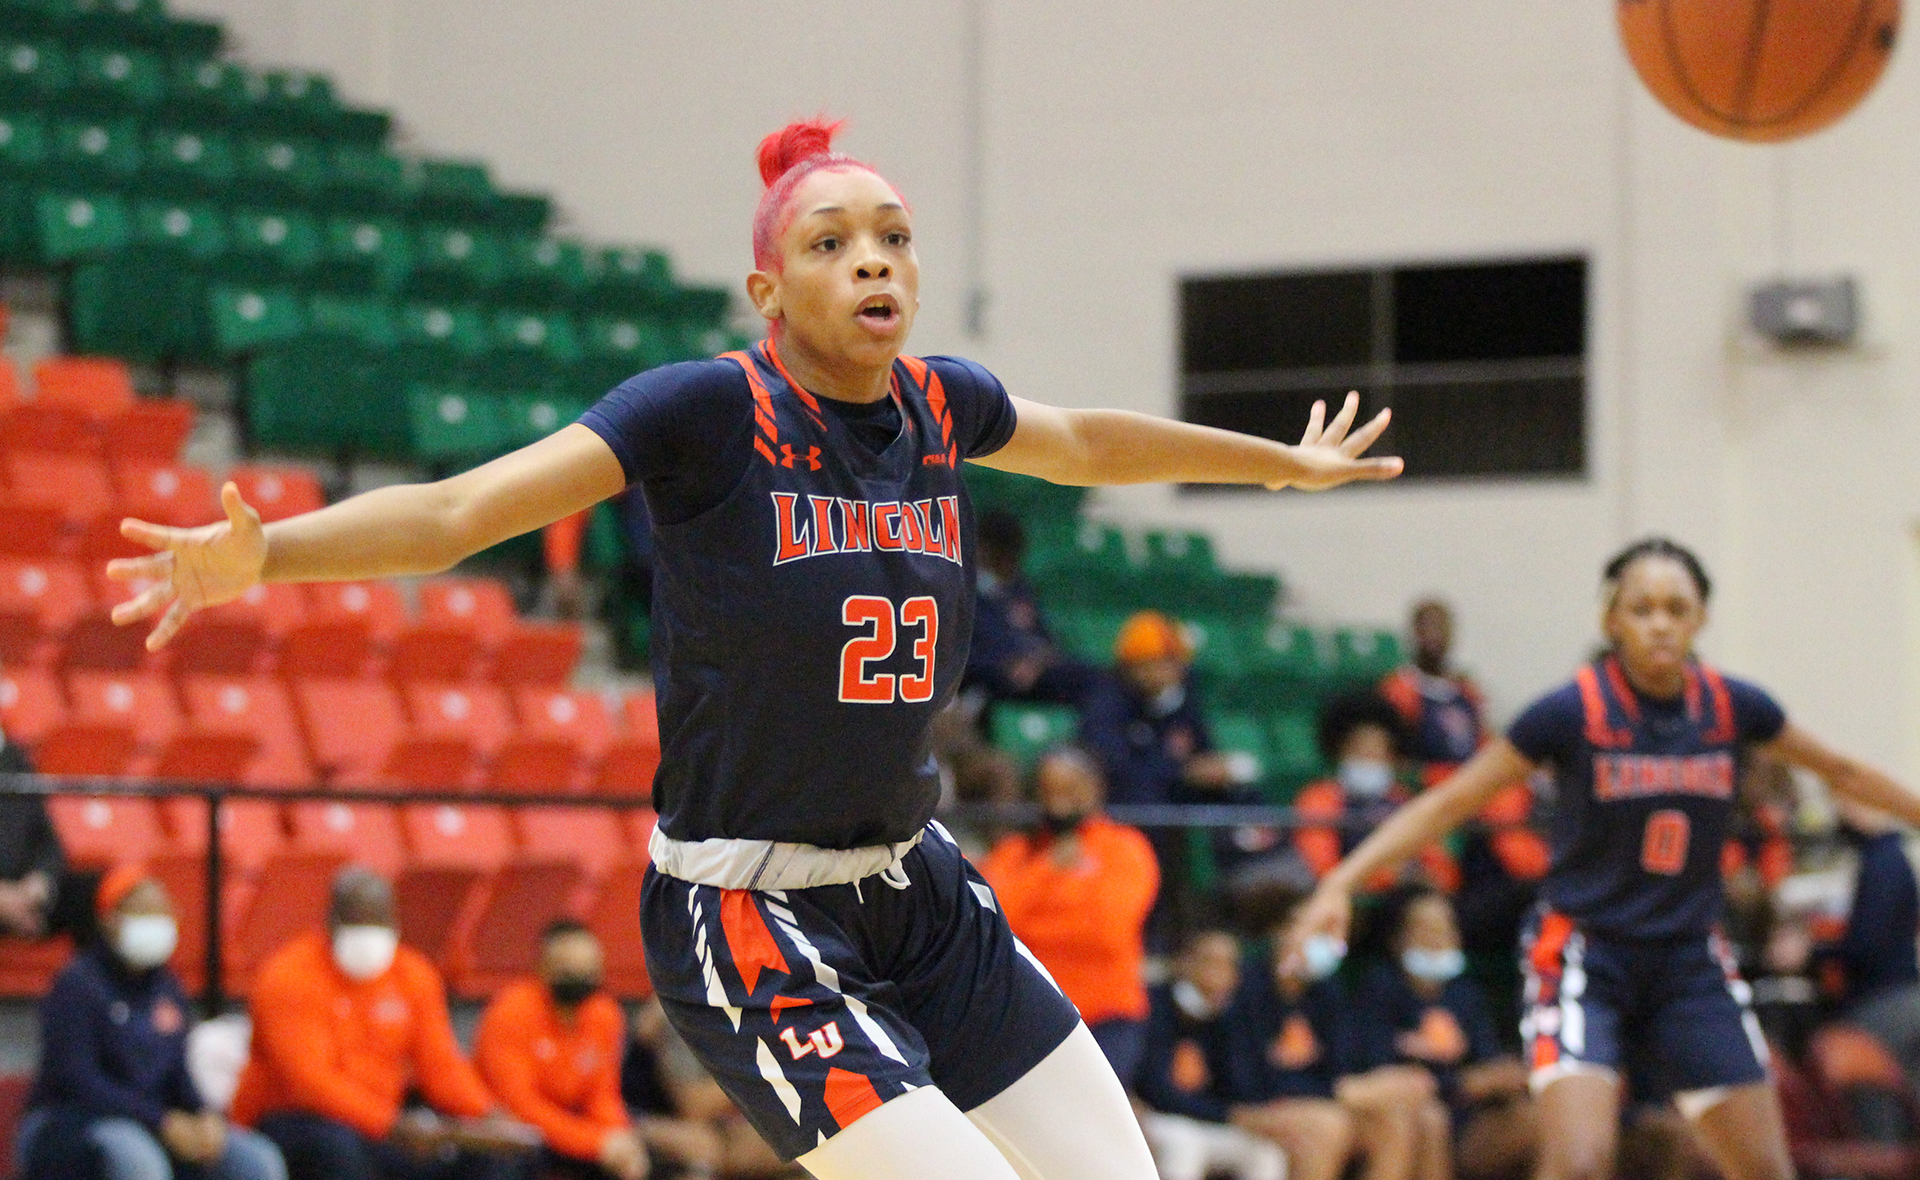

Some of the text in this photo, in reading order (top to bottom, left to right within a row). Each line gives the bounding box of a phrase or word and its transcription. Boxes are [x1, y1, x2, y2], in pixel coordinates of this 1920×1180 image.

[770, 492, 962, 566] LINCOLN
[838, 595, 938, 703] 23
[779, 1021, 845, 1060] LU
